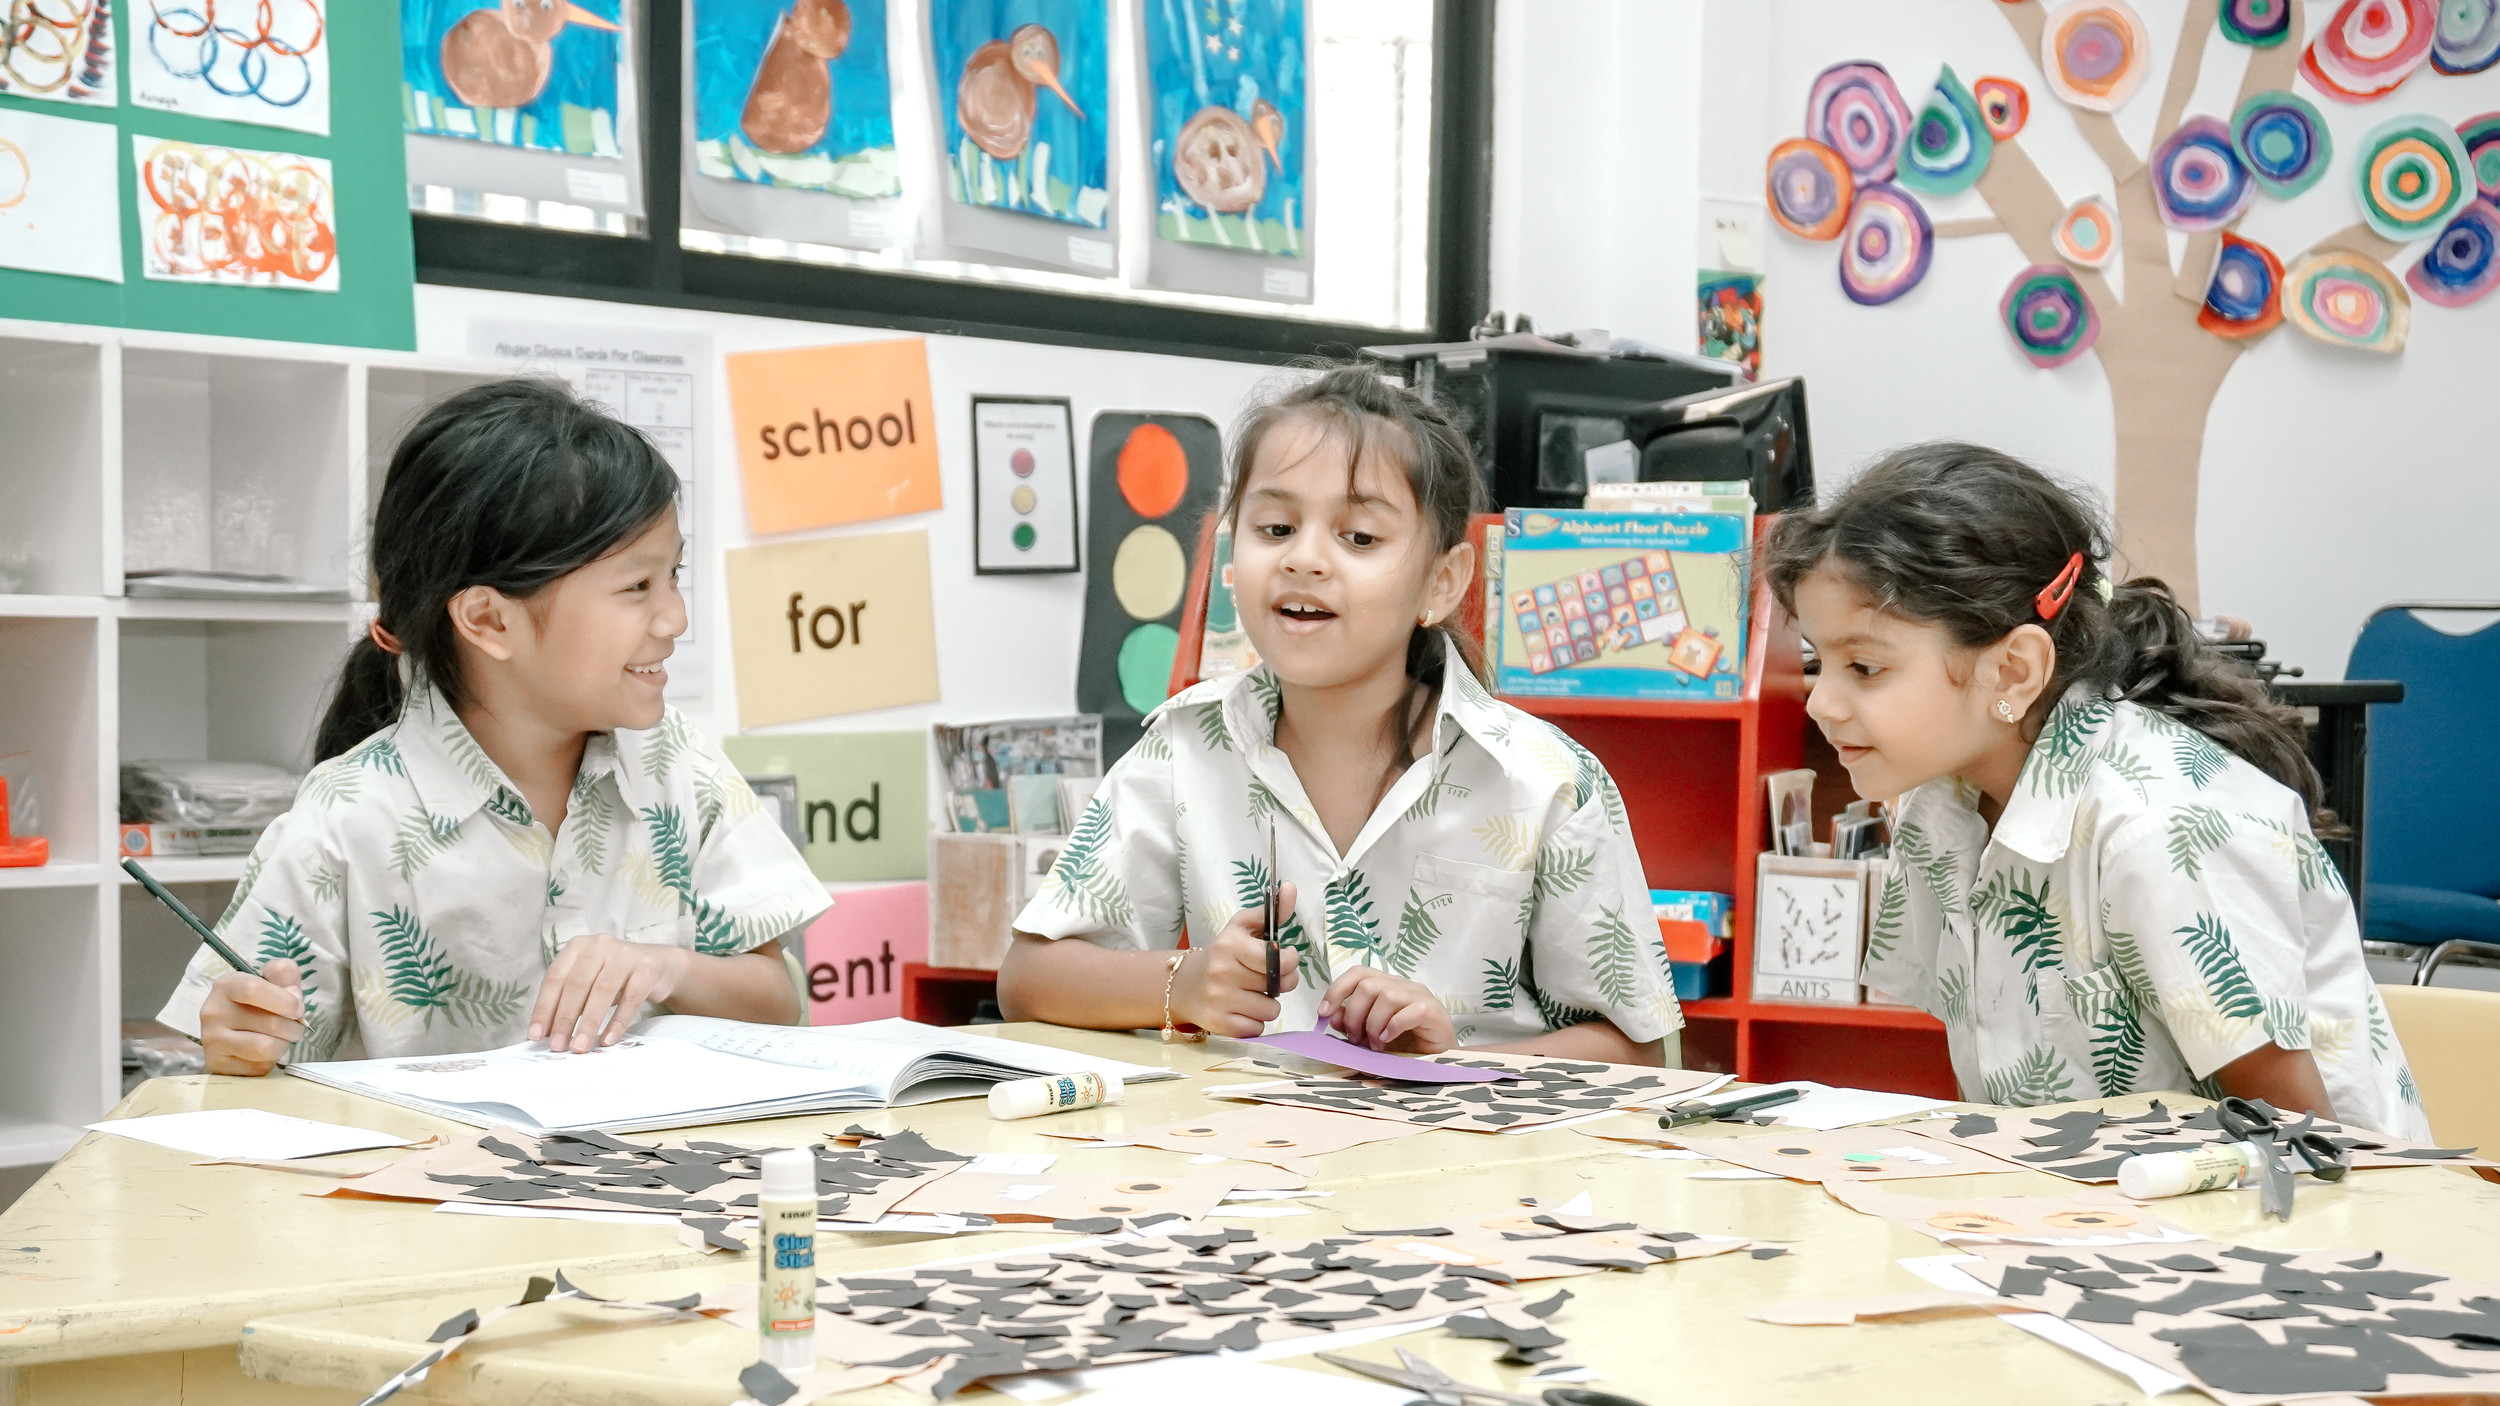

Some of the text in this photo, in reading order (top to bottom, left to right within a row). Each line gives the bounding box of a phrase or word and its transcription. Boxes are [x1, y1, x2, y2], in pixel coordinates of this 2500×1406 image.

[760, 398, 915, 460] school
[1561, 519, 1621, 536] Alphabet
[1624, 520, 1659, 534] Floor
[1663, 521, 1709, 535] Puzzle
[786, 592, 867, 653] for
[805, 782, 880, 842] nd
[807, 940, 895, 1003] ent
[1780, 979, 1831, 998] ANTS
[1057, 1080, 1067, 1107] Glue
[1064, 1076, 1077, 1105] Stick
[773, 1232, 813, 1251] Glue
[775, 1249, 814, 1269] Stick
